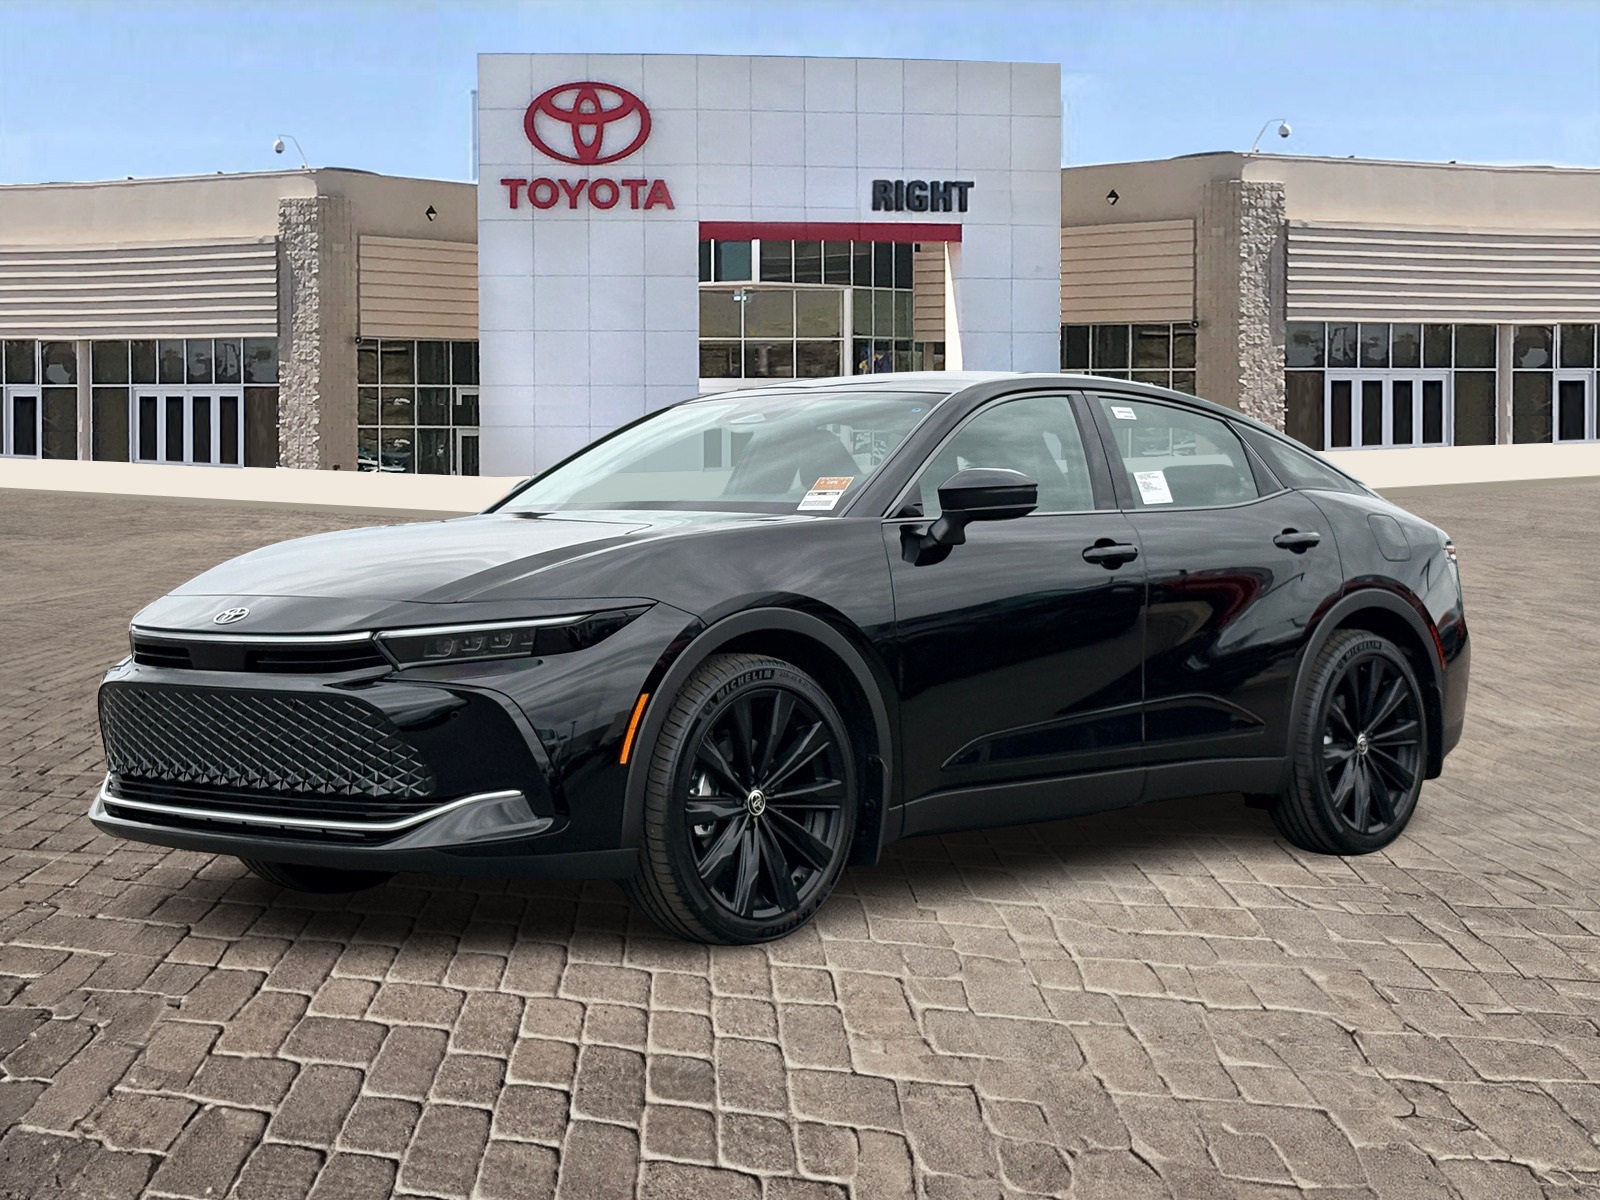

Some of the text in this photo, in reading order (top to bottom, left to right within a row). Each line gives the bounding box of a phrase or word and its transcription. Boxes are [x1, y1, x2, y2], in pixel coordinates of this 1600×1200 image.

[500, 178, 675, 210] TOYOTA
[871, 179, 975, 212] RIGHT
[716, 669, 773, 700] MICHELIN
